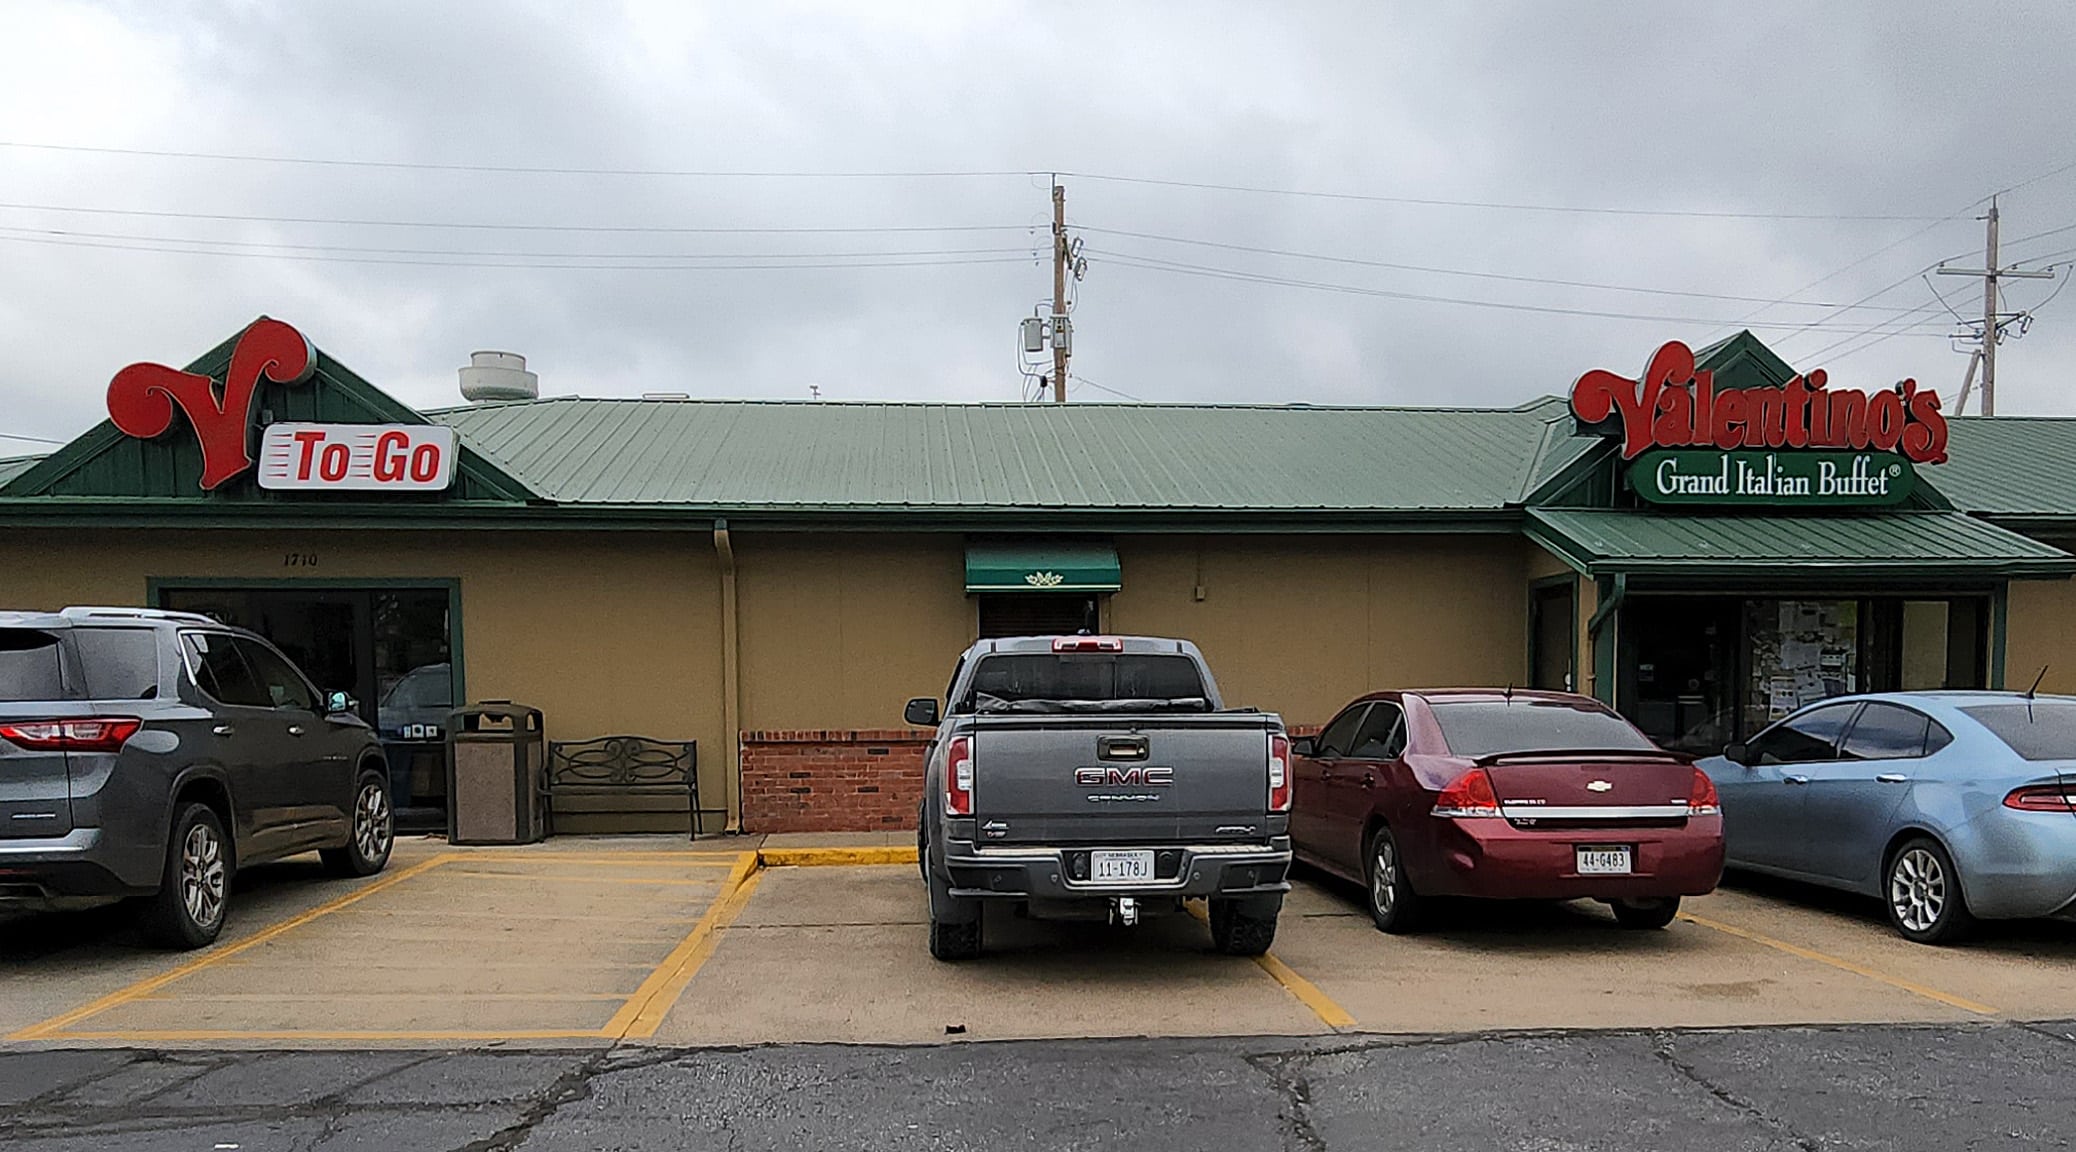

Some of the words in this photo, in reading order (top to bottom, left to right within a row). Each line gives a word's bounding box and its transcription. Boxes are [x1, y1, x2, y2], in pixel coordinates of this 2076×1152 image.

[1572, 340, 1949, 464] Valentino's
[294, 430, 350, 482] To
[373, 430, 441, 482] Go
[1656, 454, 1730, 495] Grand
[1735, 454, 1810, 495] Italian
[284, 553, 318, 567] 1710
[1074, 767, 1174, 786] GMC
[1098, 861, 1148, 877] 11-178J
[1582, 852, 1625, 867] 44-G483
